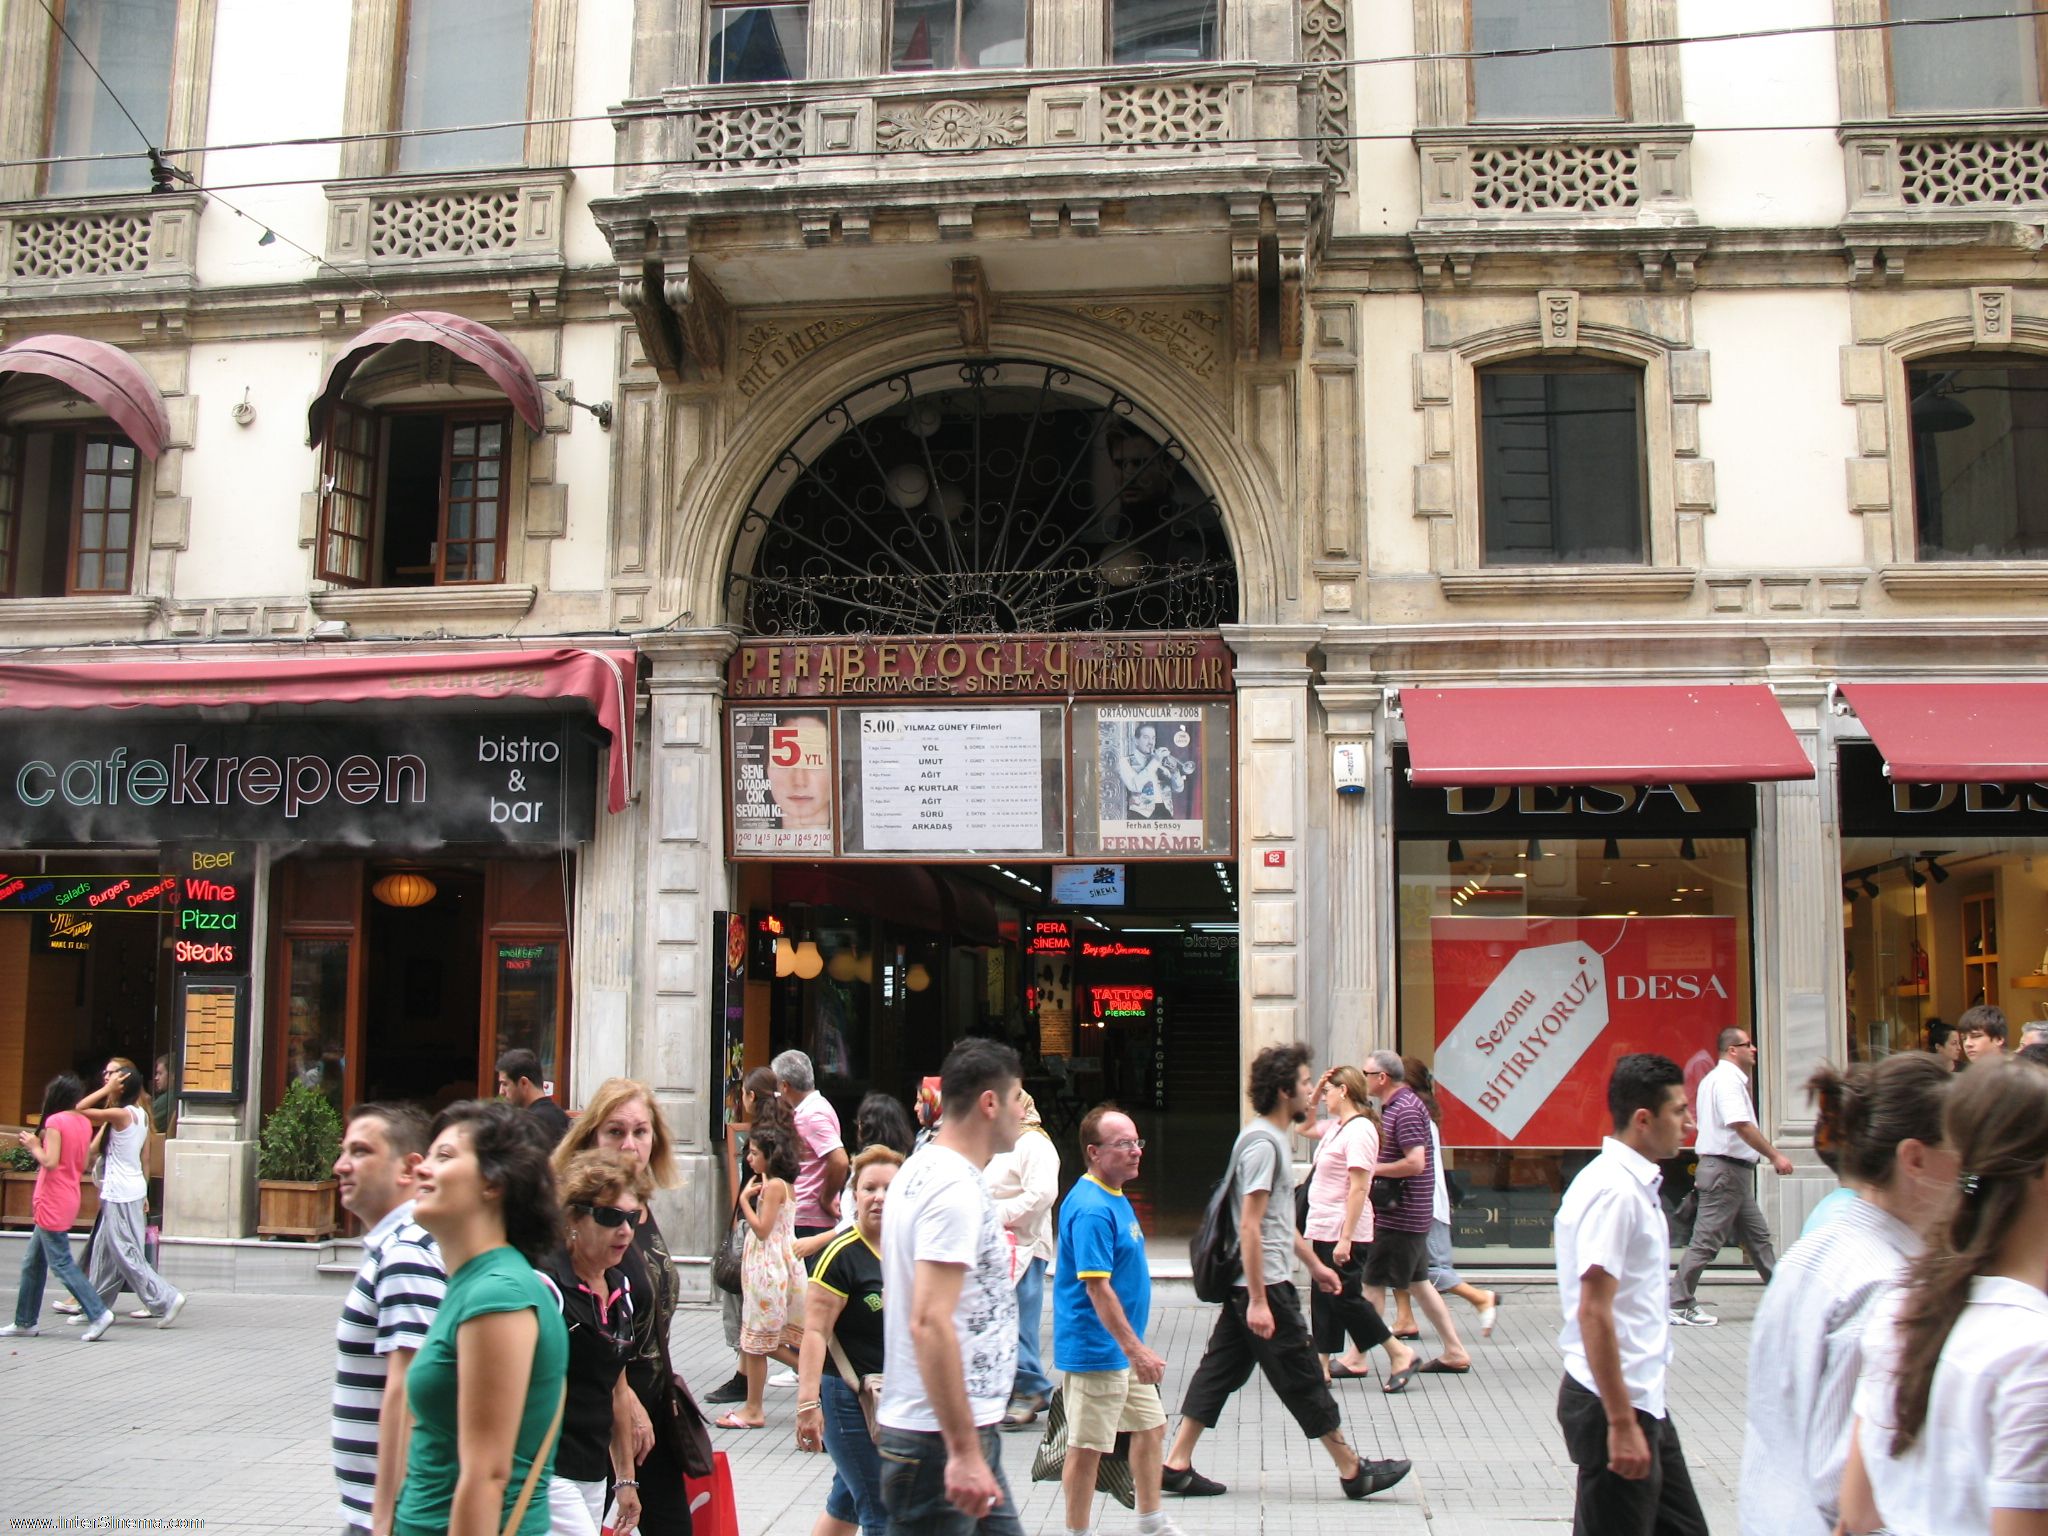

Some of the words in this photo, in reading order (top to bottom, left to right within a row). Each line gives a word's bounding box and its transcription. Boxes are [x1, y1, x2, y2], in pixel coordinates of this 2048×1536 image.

[1105, 641, 1143, 657] SES
[742, 646, 834, 678] PERA
[1075, 657, 1223, 689] ORTAOYUNCULAR
[842, 675, 950, 693] EURIMAGES
[1100, 707, 1171, 718] ORTAOYUNCULAR
[1180, 707, 1199, 718] 2008
[863, 719, 895, 734] 5.00
[904, 724, 936, 732] YILMAZ
[938, 723, 968, 731] GÜNEY
[970, 723, 1002, 731] Filmleri
[479, 735, 560, 763] bistro
[771, 730, 802, 767] 5
[805, 754, 823, 765] YTL
[17, 744, 427, 818] cafekrepen
[507, 769, 526, 791] &
[920, 770, 941, 779] AĞIT
[737, 779, 743, 790] O
[744, 779, 772, 791] KADAR
[904, 785, 916, 793] AÇ
[490, 796, 543, 823] bar
[921, 797, 942, 805] AĞIT
[920, 810, 944, 818] SÜRÜ
[912, 823, 953, 831] ARKADAŞ
[1126, 821, 1151, 829] Ferhan
[1154, 821, 1181, 831] Şensoy
[1102, 832, 1202, 850] FERNÂME
[192, 851, 236, 870] Beer
[0, 878, 26, 901] eaks
[55, 881, 91, 906] Salads
[89, 879, 131, 907] Burgers
[126, 876, 176, 908] Desserts
[186, 878, 236, 901] Wine
[182, 909, 237, 930] Pizza
[1036, 923, 1067, 933] PERA
[176, 941, 233, 963] Steaks
[1617, 975, 1728, 1000] DESA
[1475, 988, 1537, 1057] Sezonu
[1478, 969, 1598, 1114] BİTİRİYORUZ
